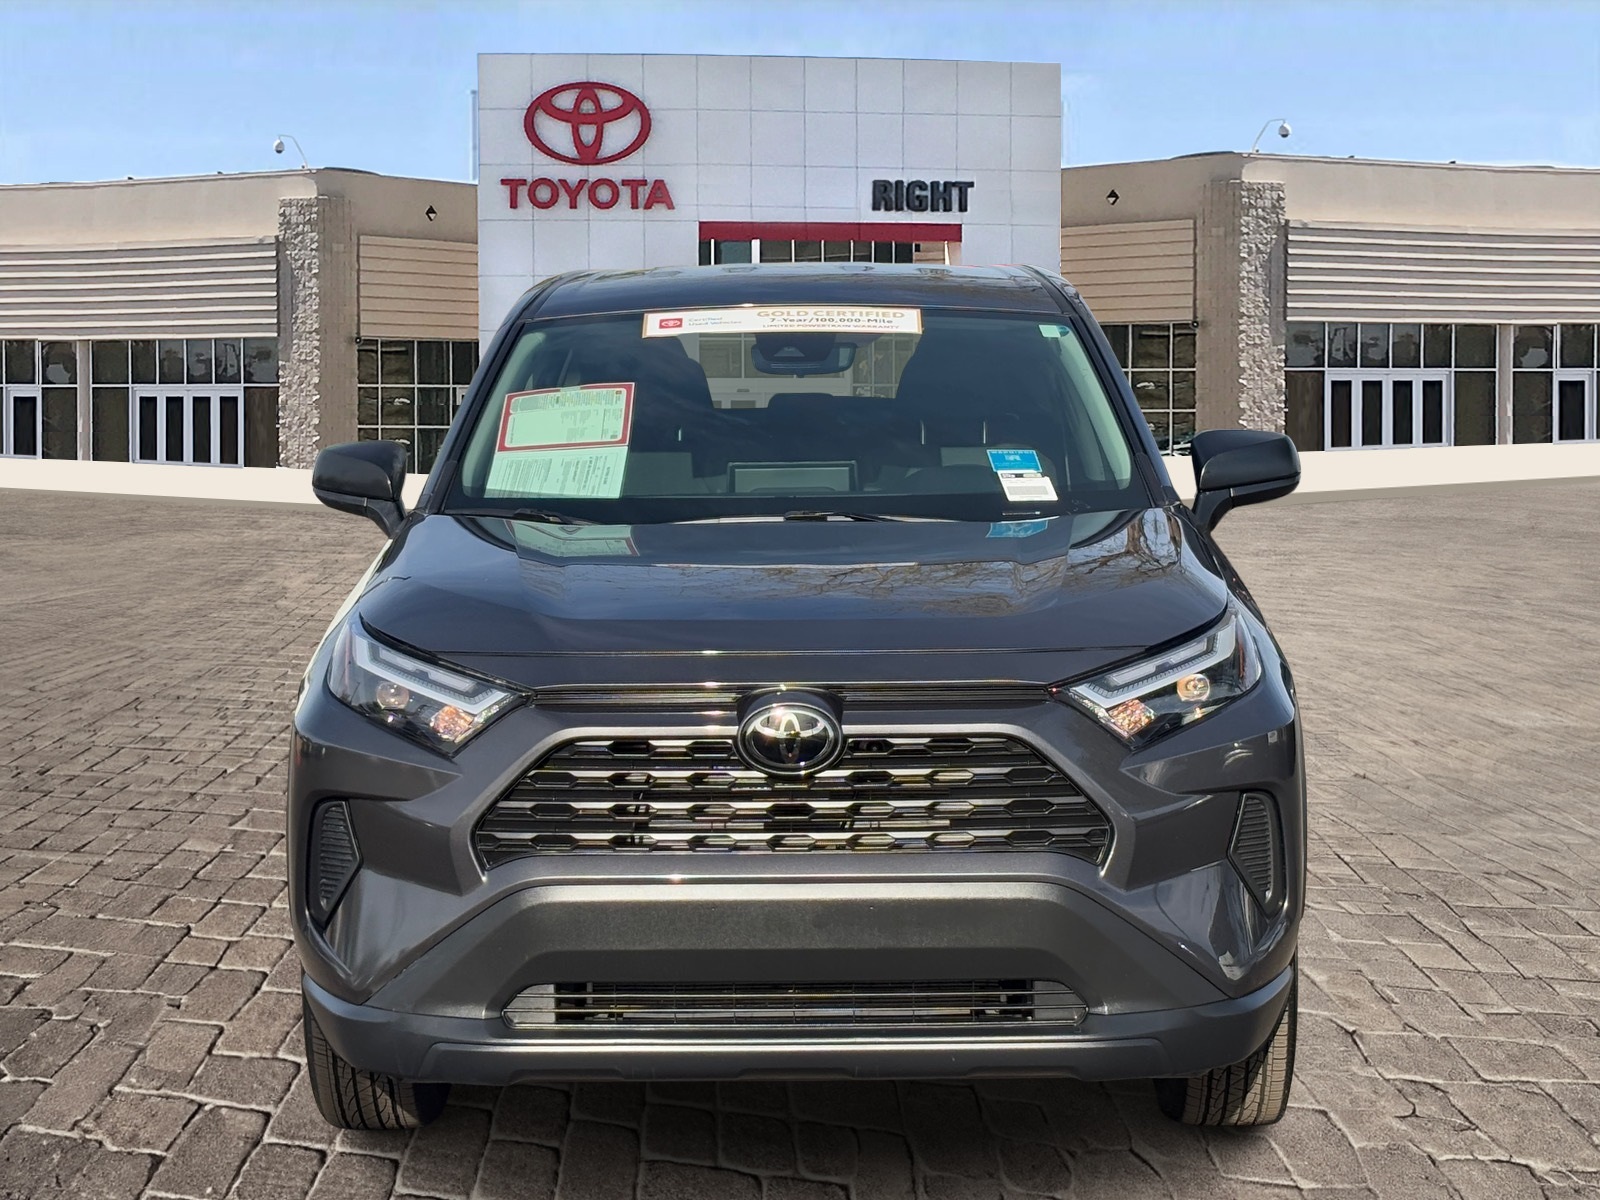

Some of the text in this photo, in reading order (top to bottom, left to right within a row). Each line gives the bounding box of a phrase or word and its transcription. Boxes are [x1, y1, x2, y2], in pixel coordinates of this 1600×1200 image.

[500, 178, 675, 209] TOYOTA
[872, 180, 974, 212] RIGHT
[813, 310, 905, 318] CERTIFIED
